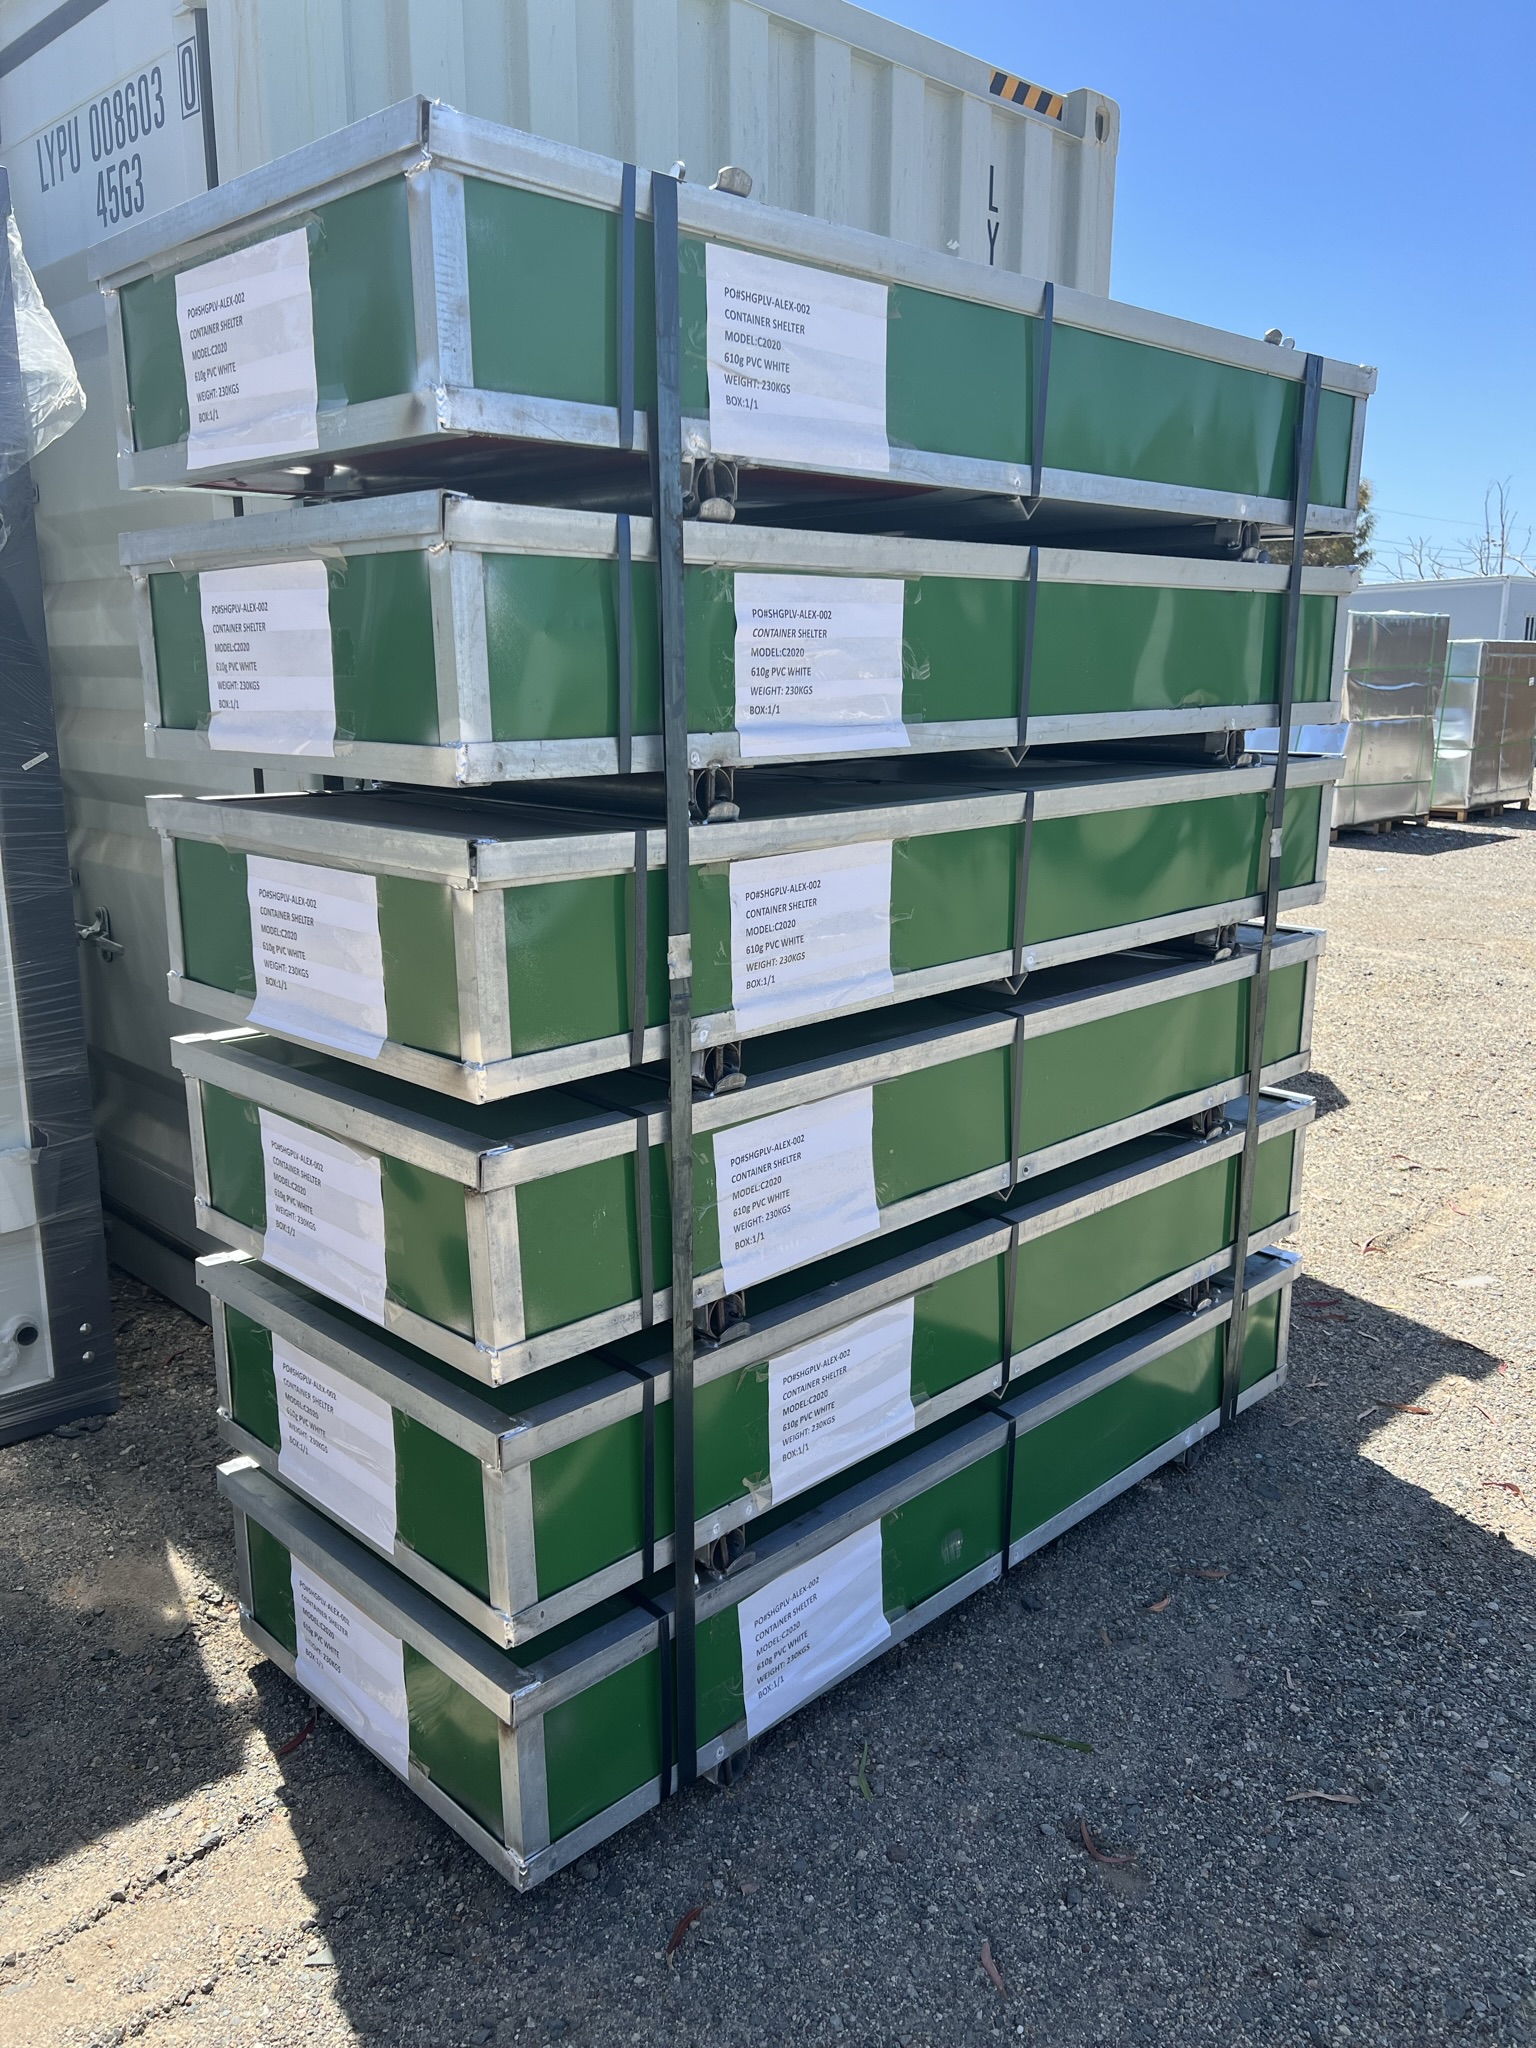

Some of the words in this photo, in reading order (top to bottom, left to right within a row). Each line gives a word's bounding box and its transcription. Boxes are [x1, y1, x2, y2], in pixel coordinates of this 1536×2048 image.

[37, 116, 81, 193] LYPU
[89, 66, 165, 162] 008603
[182, 45, 196, 110] 0
[96, 153, 144, 228] 45G3
[188, 292, 245, 319] PO#SHGPLV-ALEX-002
[724, 287, 810, 315] PO#SHGPLV-ALEX-002
[190, 323, 220, 340] CONTAINER
[220, 316, 243, 331] SHELTER
[725, 309, 770, 328] CONTAINER
[772, 319, 805, 335] SHELTER
[725, 330, 781, 350] MODEL:C2020
[192, 342, 227, 360] MODEL:C2020
[194, 372, 206, 382] 610g
[207, 367, 216, 379] PVC
[218, 362, 236, 375] WHITE
[724, 352, 744, 367] 610g
[746, 356, 762, 368] PVC
[764, 360, 790, 373] WHITE
[196, 388, 218, 402] WEIGHT:
[219, 383, 239, 398] 230KGS
[724, 374, 760, 389] WEIGHT:
[762, 380, 790, 394] 230KGS
[726, 395, 758, 410] BOX:1/1
[199, 409, 219, 423] BOX:1/1
[212, 602, 268, 614] PO#SHGPLV-ALEX-002
[752, 609, 832, 620] PO#SHGPLV-ALEX-002
[213, 623, 242, 633] CONTAINER
[243, 622, 266, 632] SHELTER
[752, 628, 796, 638] CONTAINER
[798, 629, 827, 638] SHELTER
[214, 643, 250, 652] MODEL:C2020
[751, 648, 804, 657] MODEL:C2020
[216, 663, 228, 673] 610g
[228, 662, 239, 671] PVC
[240, 662, 257, 671] WHITE
[751, 667, 769, 678] 610g
[771, 667, 786, 676] PVC
[788, 667, 811, 676] WHITE
[217, 681, 238, 690] WEIGHT:
[240, 681, 260, 690] 230KGS
[751, 686, 783, 695] WEIGHT:
[785, 686, 813, 695] 230KGS
[219, 699, 239, 710] BOX:1/1
[750, 704, 780, 716] BOX:1/1
[259, 889, 317, 908] PO#SHGPLV-ALEX-002
[745, 880, 821, 901] PO#SHGPLV-ALEX-002
[260, 907, 290, 921] CONTAINER
[291, 915, 314, 926] SHELTER
[746, 903, 787, 919] CONTAINER
[788, 898, 817, 910] SHELTER
[261, 924, 297, 941] MODEL:C2020
[746, 919, 796, 937] MODEL:C2020
[263, 942, 275, 954] 610g
[276, 946, 286, 955] PVC
[287, 948, 305, 960] WHITE
[746, 944, 763, 954] 610g
[765, 940, 779, 951] PVC
[781, 935, 804, 947] WHITE
[264, 959, 287, 972] WEIGHT:
[288, 965, 309, 978] 230KGS
[746, 959, 777, 972] WEIGHT:
[779, 952, 806, 965] 230KGS
[265, 977, 287, 990] BOX:1/1
[746, 975, 775, 989] BOX:1/1
[271, 1141, 324, 1172] PO#SHGPLV-ALEX-002
[730, 1134, 805, 1167] PO#SHGPLV-ALEX-002
[273, 1157, 300, 1176] CONTAINER
[300, 1170, 321, 1187] SHELTER
[731, 1162, 772, 1184] CONTAINER
[773, 1152, 802, 1169] SHELTER
[273, 1172, 306, 1196] MODEL:C2020
[732, 1176, 782, 1200] MODEL:C2020
[274, 1189, 286, 1203] 610g
[287, 1195, 296, 1206] PVC
[296, 1199, 313, 1215] WHITE
[733, 1206, 750, 1217] 610g
[752, 1198, 766, 1210] PVC
[767, 1189, 790, 1204] WHITE
[275, 1204, 296, 1221] WEIGHT:
[297, 1216, 316, 1231] 230KGS
[733, 1215, 764, 1233] WEIGHT:
[765, 1204, 791, 1221] 230KGS
[276, 1220, 296, 1237] BOX:1/1
[735, 1232, 764, 1250] BOX:1/1
[783, 1349, 851, 1385] PO#SHGPLV-ALEX-002
[783, 1378, 820, 1401] CONTAINER
[821, 1366, 847, 1384] SHELTER
[283, 1378, 311, 1400] CONTAINER
[312, 1395, 333, 1414] SHELTER
[285, 1392, 319, 1419] MODEL:C2020
[783, 1390, 828, 1416] MODEL:C2020
[299, 1415, 308, 1427] PVC
[309, 1421, 326, 1438] WHITE
[783, 1420, 798, 1431] 610g
[800, 1412, 812, 1424] PVC
[814, 1401, 835, 1416] WHITE
[288, 1421, 308, 1440] WEIGHT:
[309, 1436, 328, 1453] 230KGS
[782, 1428, 810, 1446] WEIGHT:
[812, 1415, 836, 1433] 230KGS
[783, 1443, 809, 1462] BOX:1/1
[754, 1576, 820, 1628] PO#SHGPLV-ALEX-002
[301, 1594, 328, 1620] CONTAINER
[328, 1616, 348, 1637] SHELTER
[302, 1607, 334, 1639] MODEL:C2020
[755, 1612, 792, 1642] CONTAINER
[793, 1593, 817, 1616] SHELTER
[314, 1631, 323, 1644] PVC
[324, 1641, 340, 1659] WHITE
[756, 1621, 800, 1656] MODEL:C2020
[757, 1657, 772, 1671] 610g
[774, 1646, 787, 1659] PVC
[788, 1630, 808, 1649] WHITE
[323, 1652, 341, 1673] 230KGS
[757, 1661, 785, 1685] WEIGHT:
[787, 1643, 810, 1665] 230KGS
[758, 1675, 784, 1699] BOX:1/1
